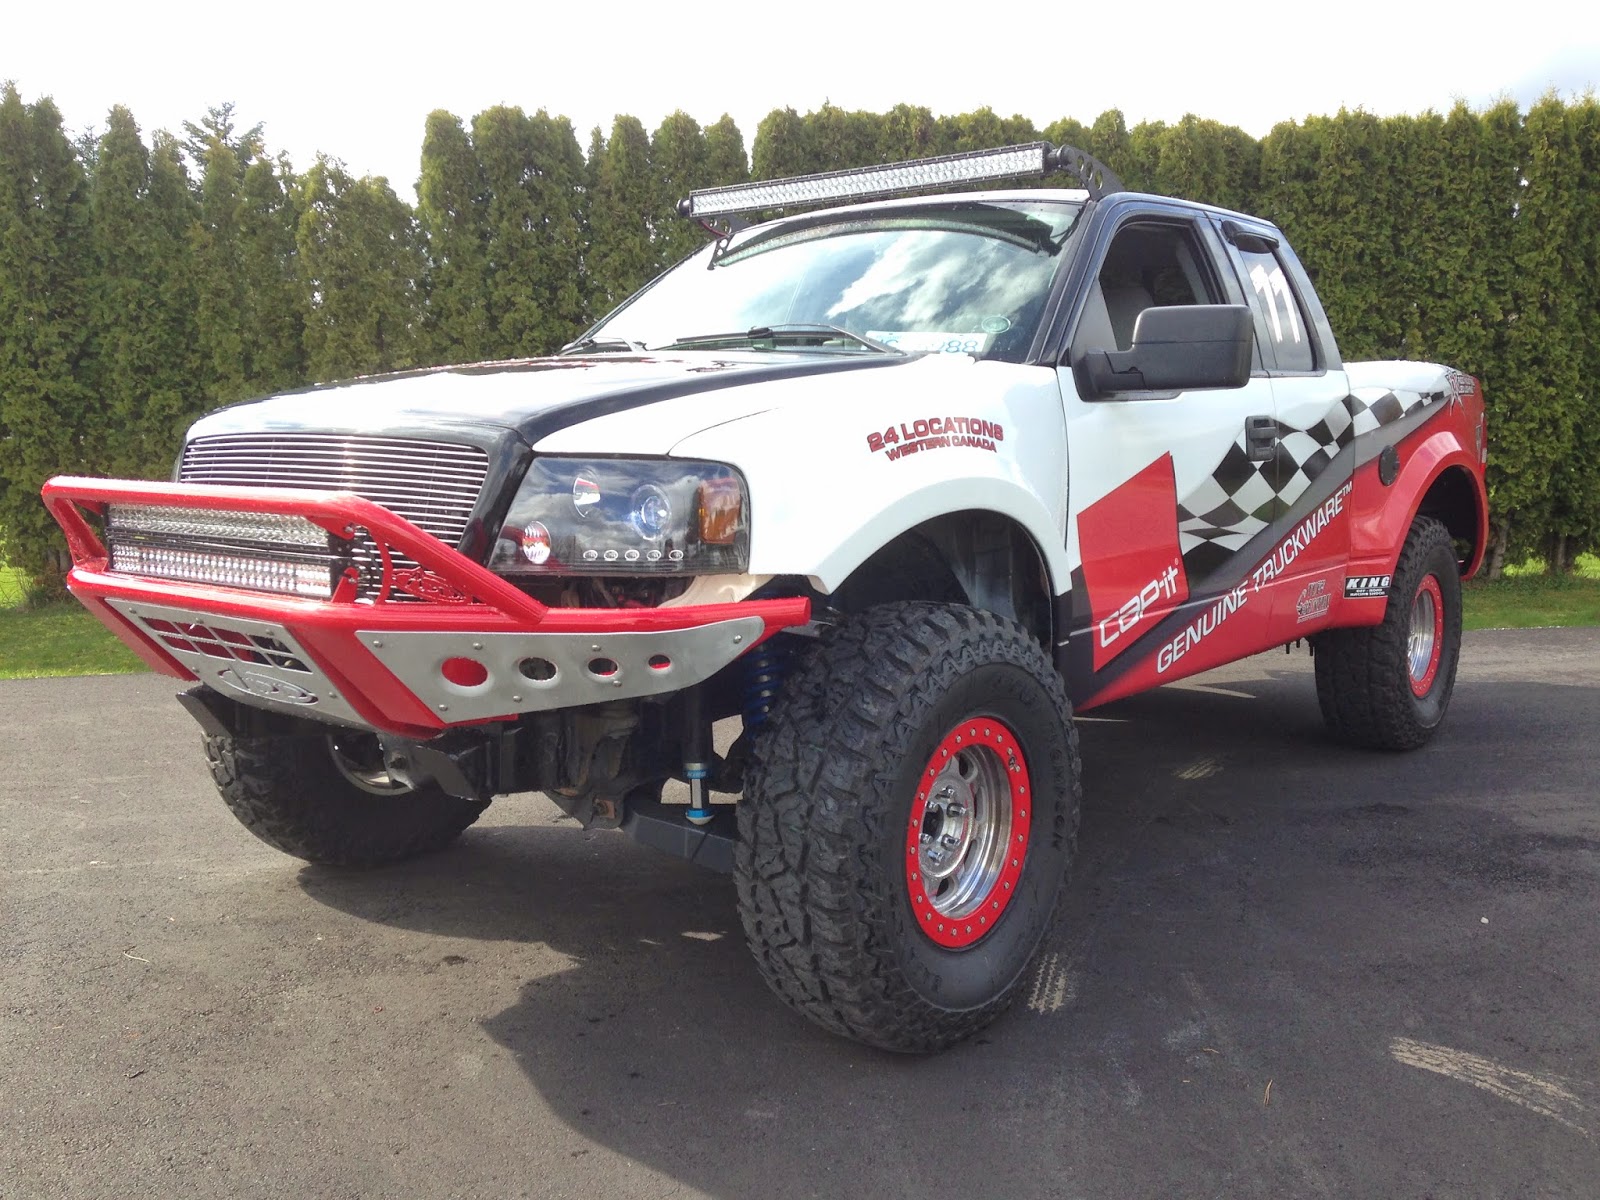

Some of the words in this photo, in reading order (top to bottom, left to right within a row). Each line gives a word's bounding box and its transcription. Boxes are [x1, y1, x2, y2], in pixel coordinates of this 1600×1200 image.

[866, 426, 900, 453] 24
[900, 417, 1004, 442] LOCATIONS
[885, 436, 951, 461] WESTERN
[951, 435, 997, 453] CANADA
[1346, 576, 1390, 588] KING
[1157, 579, 1249, 674] GENUINE
